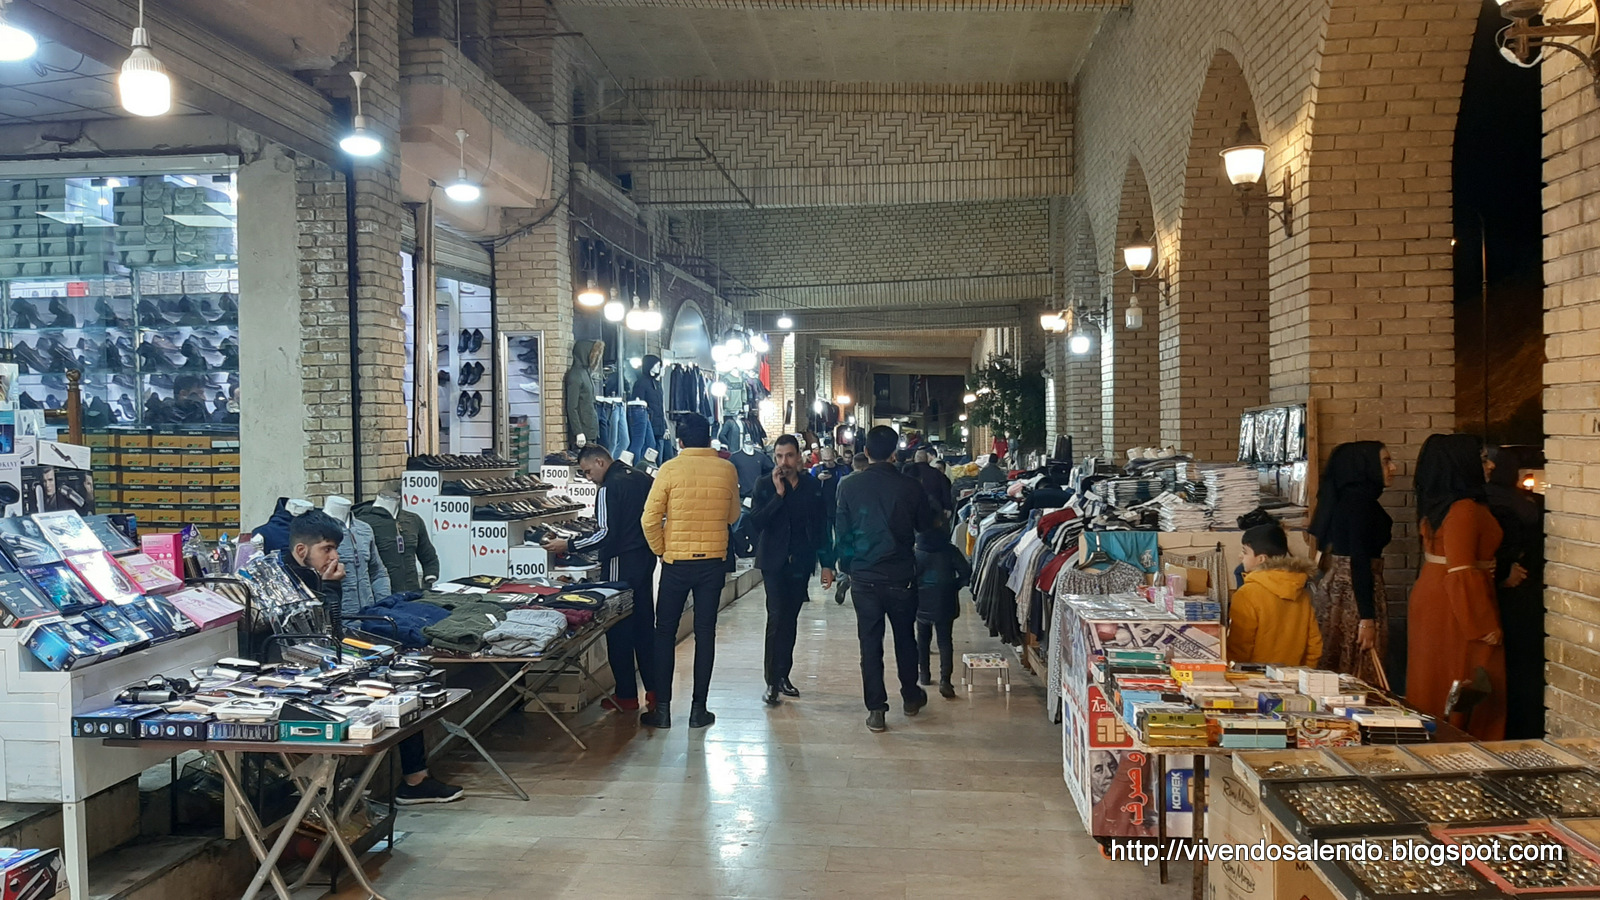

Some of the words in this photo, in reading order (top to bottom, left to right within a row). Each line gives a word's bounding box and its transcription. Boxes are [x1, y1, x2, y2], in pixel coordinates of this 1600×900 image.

[541, 469, 569, 478] 15000
[402, 476, 438, 488] 15000
[568, 487, 596, 497] 15000
[403, 493, 432, 507] ١٥٠٠
[433, 501, 470, 513] 15000
[471, 526, 507, 539] 15000
[472, 543, 507, 558] ١٥٠٠٠
[508, 563, 545, 576] 15000
[1171, 771, 1182, 811] KOREK
